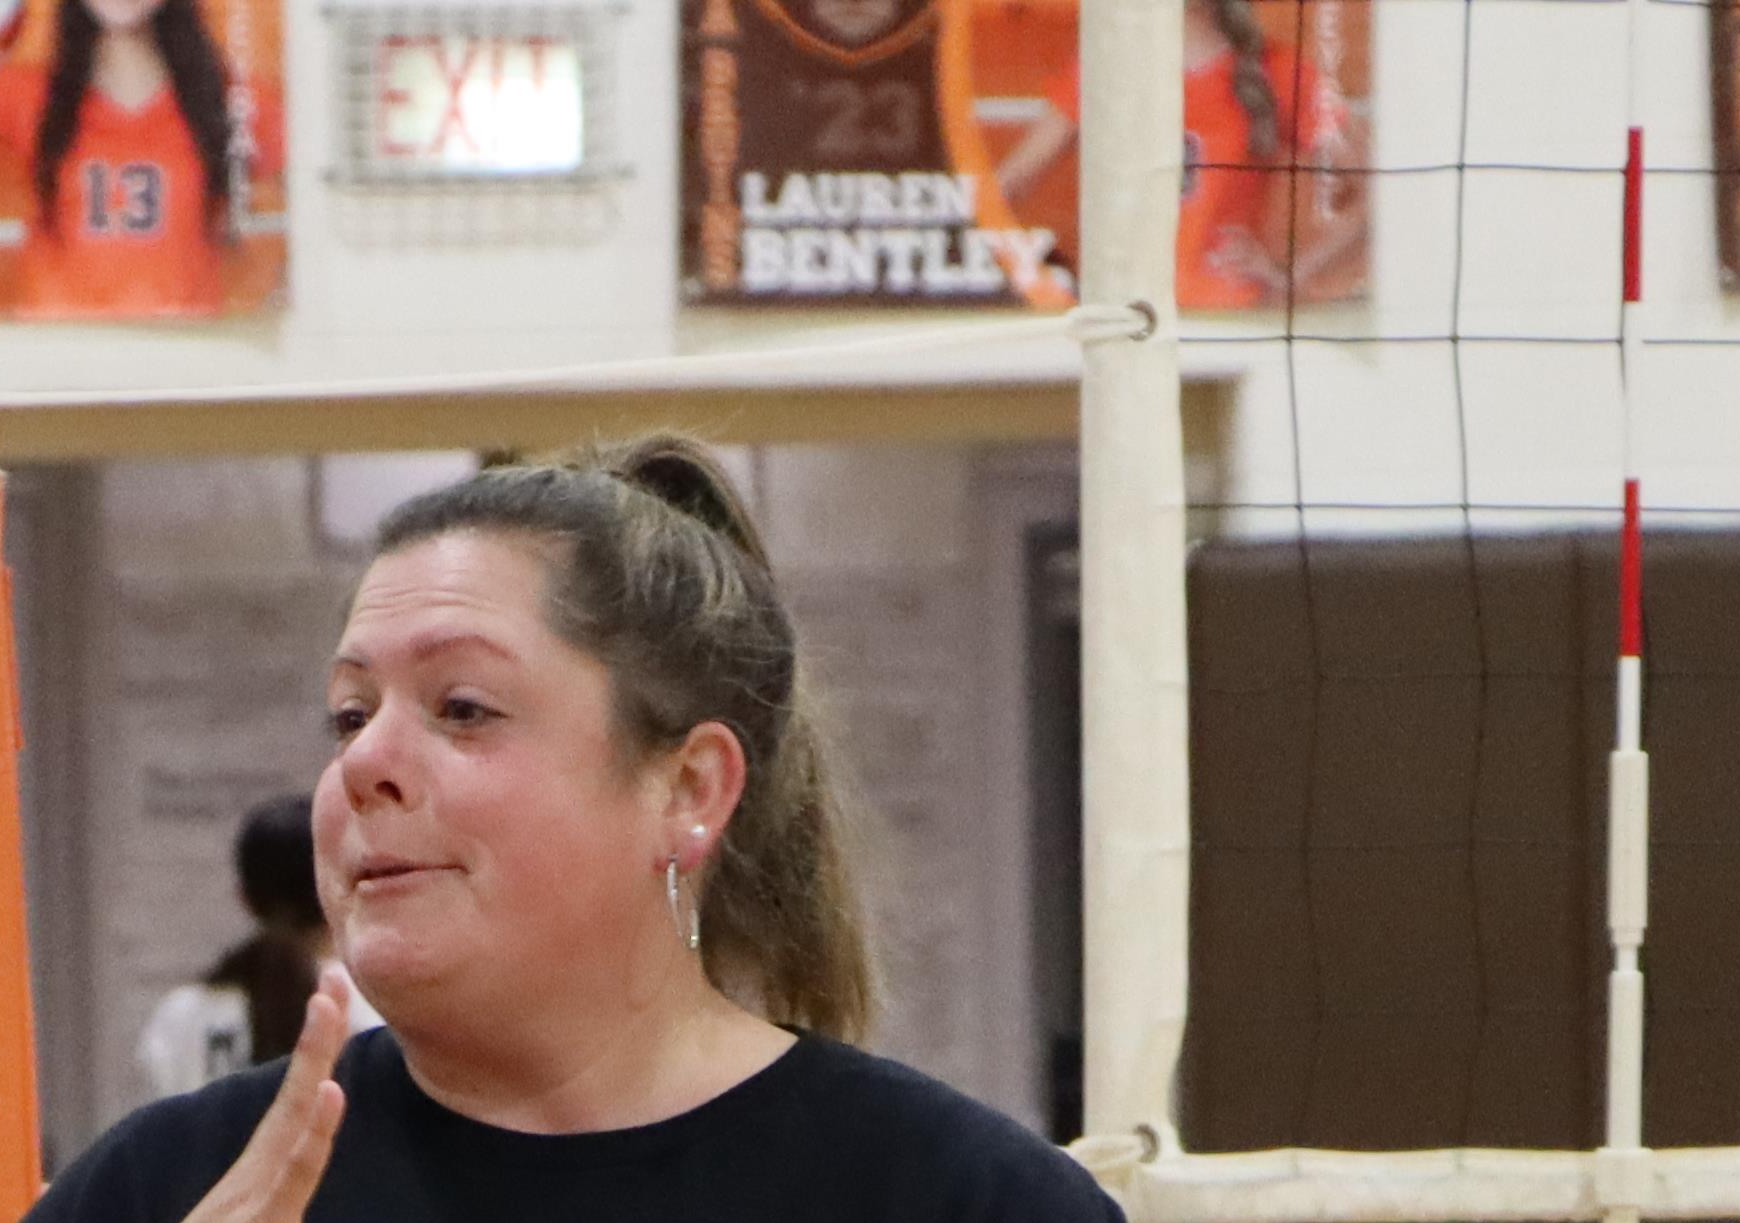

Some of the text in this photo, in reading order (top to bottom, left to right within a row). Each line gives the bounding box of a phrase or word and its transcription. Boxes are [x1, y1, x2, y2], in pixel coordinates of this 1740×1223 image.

[375, 36, 570, 155] EXIT
[82, 161, 167, 234] 13
[740, 172, 977, 222] LAUREN
[741, 228, 1056, 294] BENTLEY
